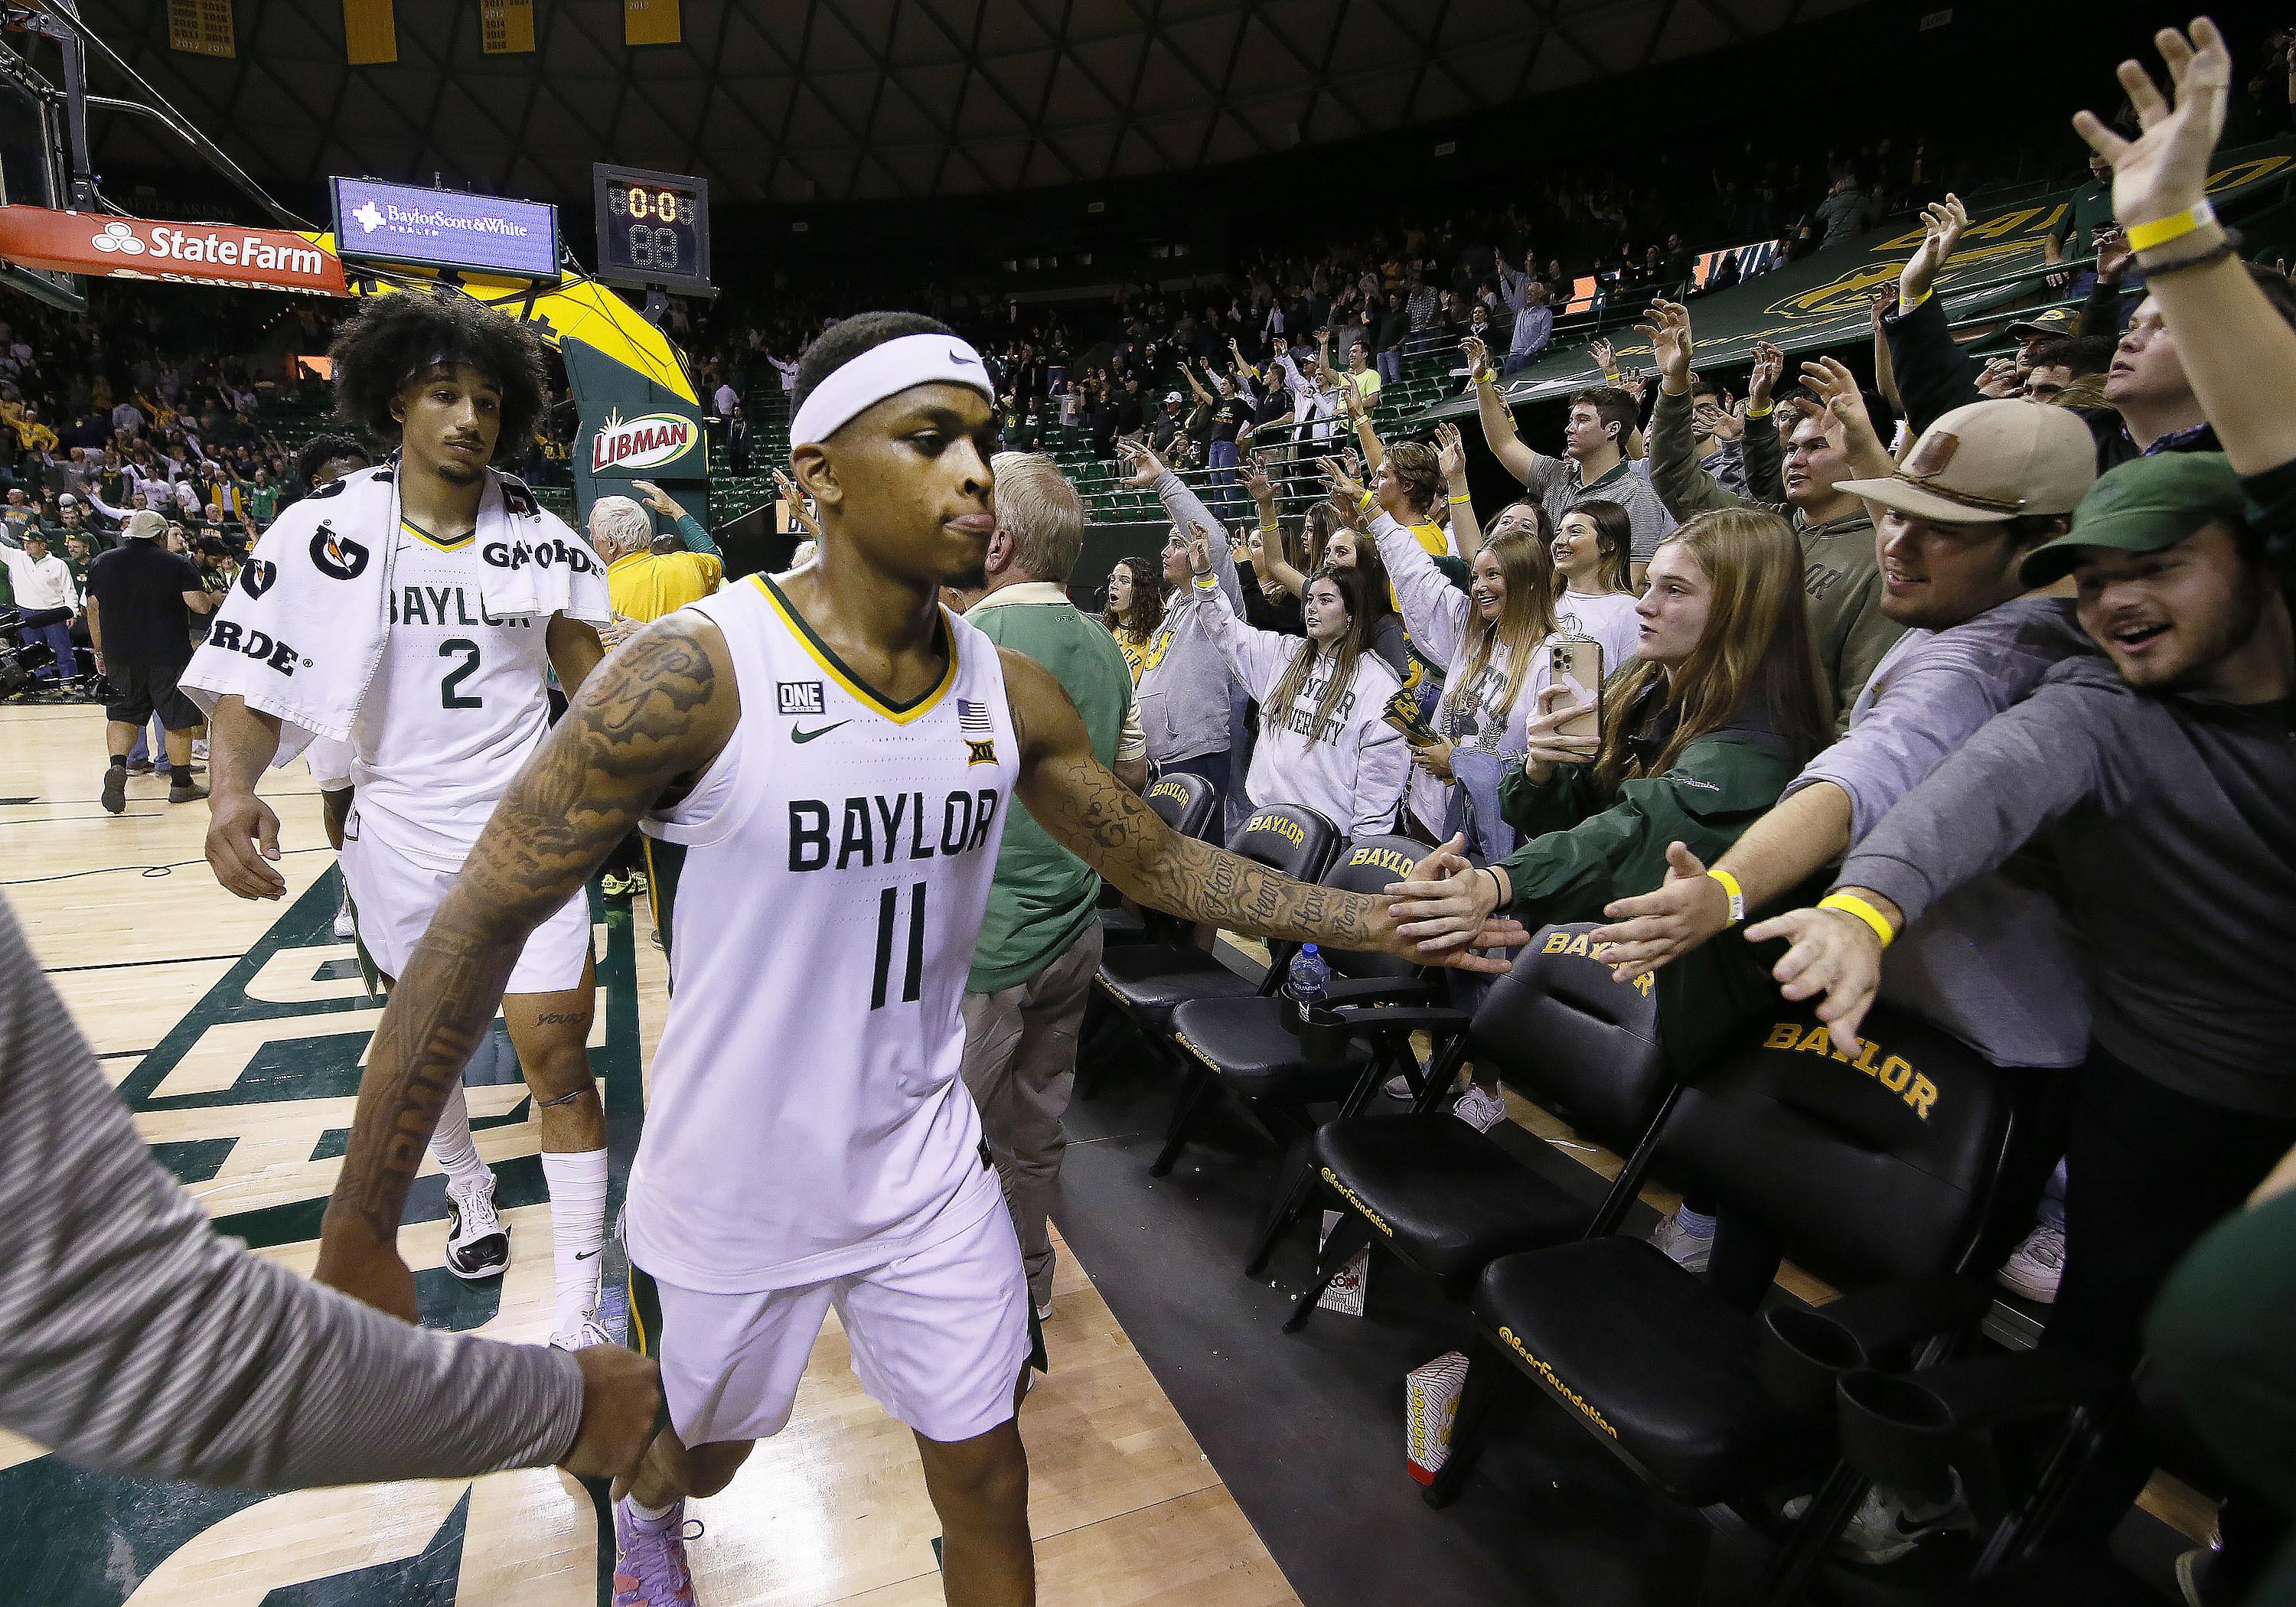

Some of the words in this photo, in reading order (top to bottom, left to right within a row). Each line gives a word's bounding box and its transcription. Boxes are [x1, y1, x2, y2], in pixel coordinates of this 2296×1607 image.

[593, 422, 688, 471] LIBMAN
[438, 638, 483, 709] 2
[780, 683, 822, 707] ONE
[788, 787, 999, 872] BAYLOR
[1150, 781, 1190, 811] BAYLOR
[1247, 815, 1305, 850] BAYLOR
[1349, 846, 1416, 880] BAYLO
[870, 881, 927, 1011] 11
[1321, 1166, 1394, 1239] @BearFoundation
[1498, 1325, 1619, 1439] @BearFoundation
[1412, 1385, 1427, 1462] POPCORN
